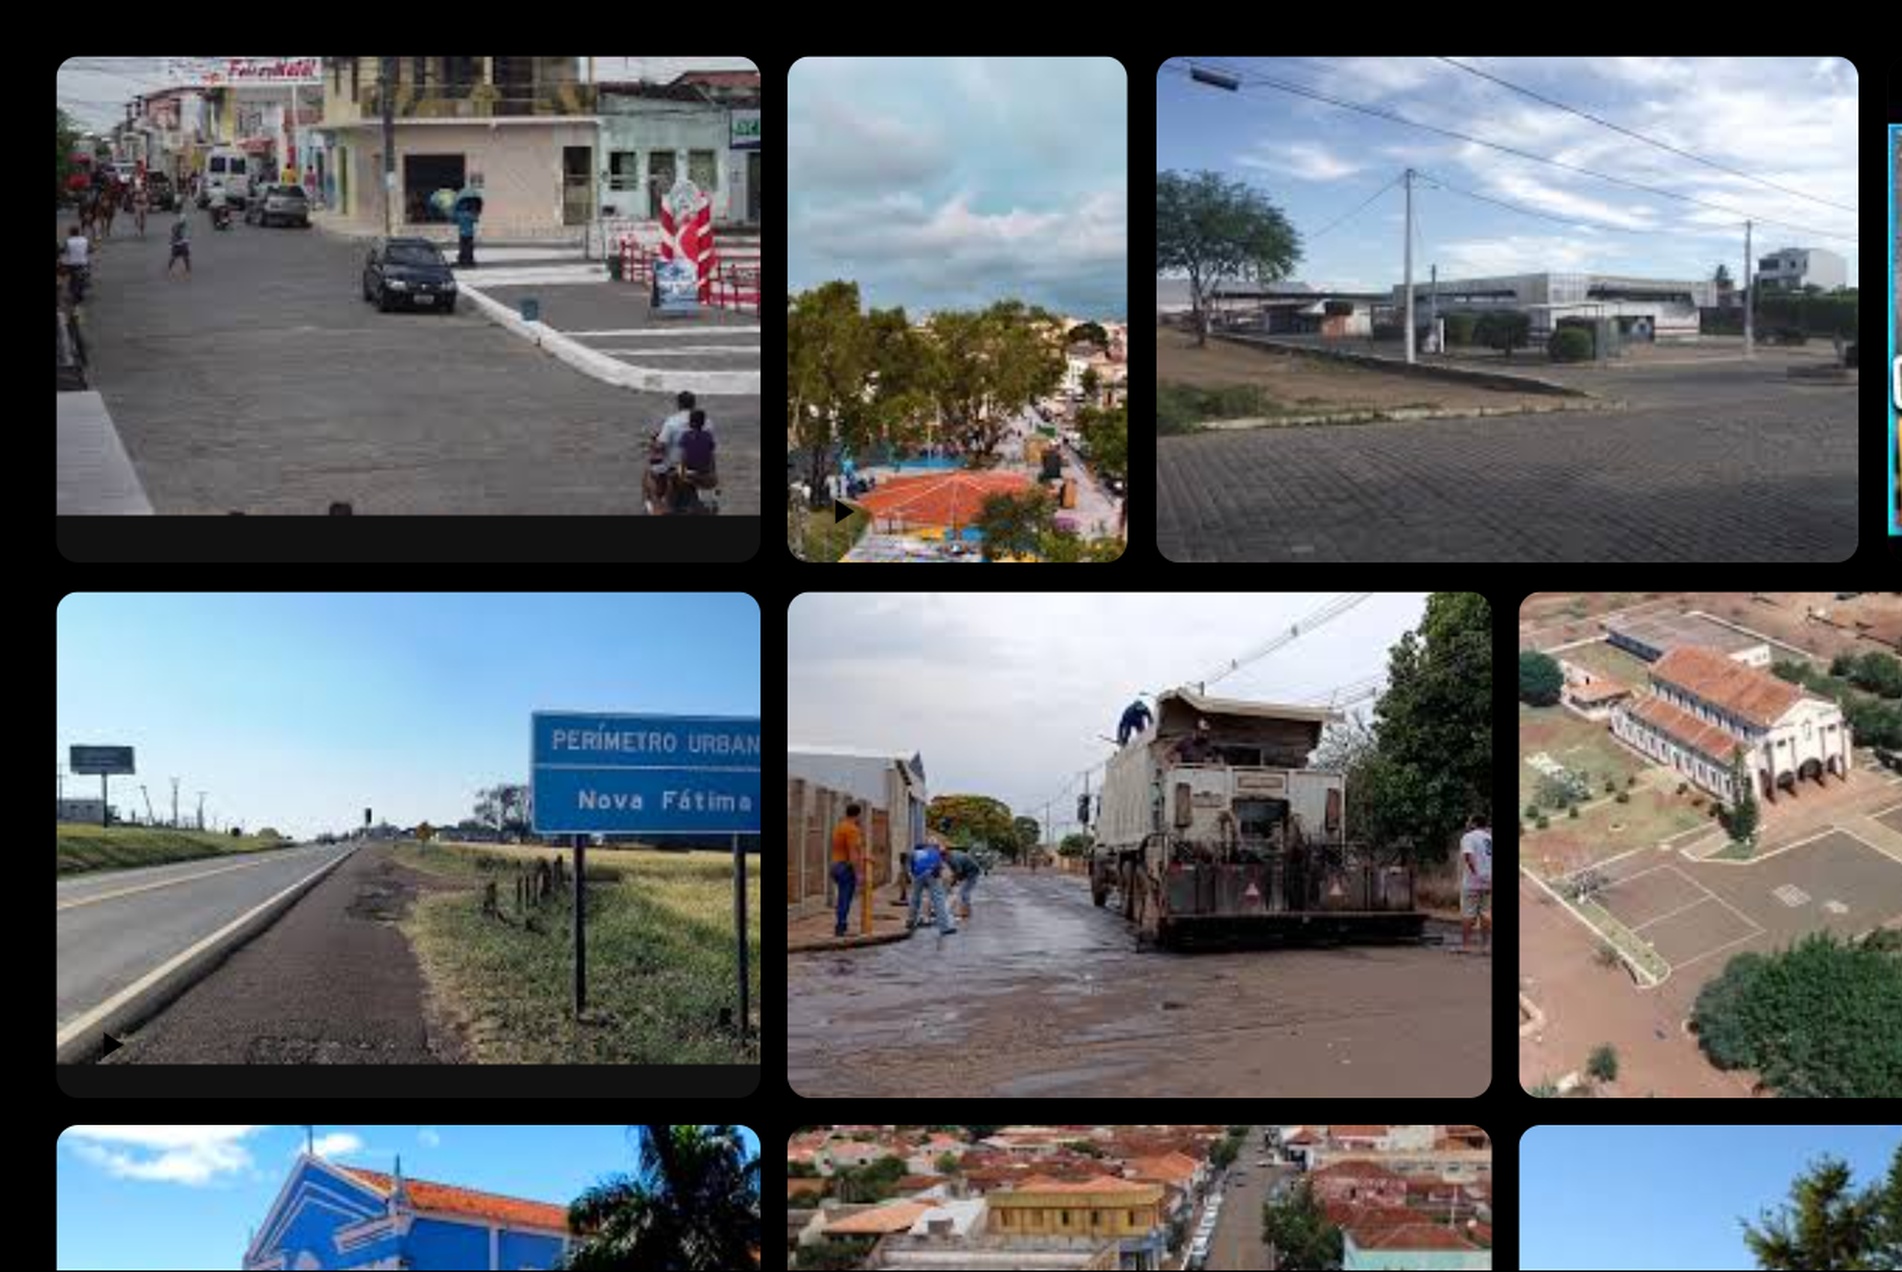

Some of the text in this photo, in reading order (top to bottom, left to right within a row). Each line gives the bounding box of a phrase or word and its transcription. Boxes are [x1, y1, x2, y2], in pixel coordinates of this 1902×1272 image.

[552, 723, 679, 754] PERÍMETRO
[578, 788, 753, 813] Nova Fátima
